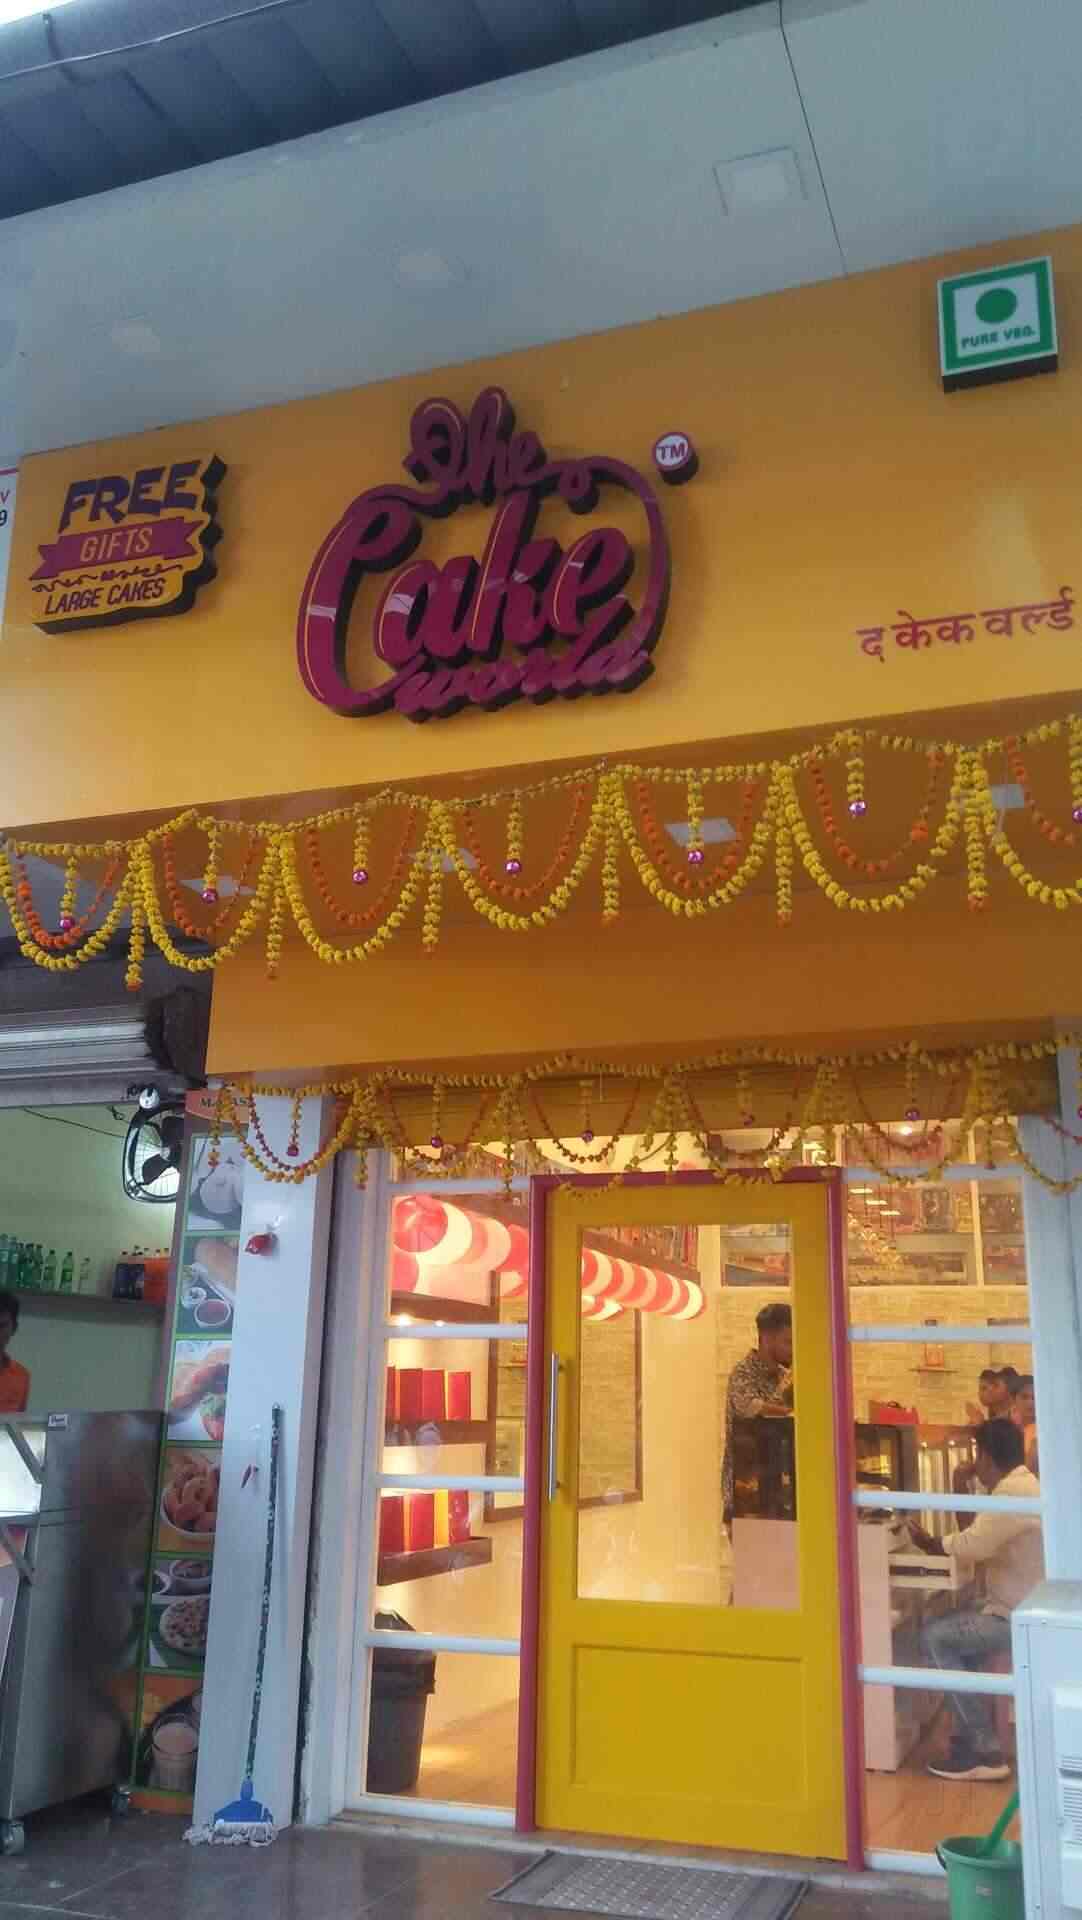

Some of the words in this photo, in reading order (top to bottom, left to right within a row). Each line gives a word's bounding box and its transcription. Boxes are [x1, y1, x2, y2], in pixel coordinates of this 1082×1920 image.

[961, 331, 999, 349] PURE
[656, 442, 688, 461] TM
[58, 459, 203, 534] FREE
[80, 528, 153, 562] GIFTS
[45, 587, 105, 615] LARGE
[107, 577, 167, 605] CAKES
[296, 487, 636, 716] Cake
[855, 627, 886, 664] द
[890, 609, 977, 651] केक
[979, 585, 1075, 637] वर्ल्ड
